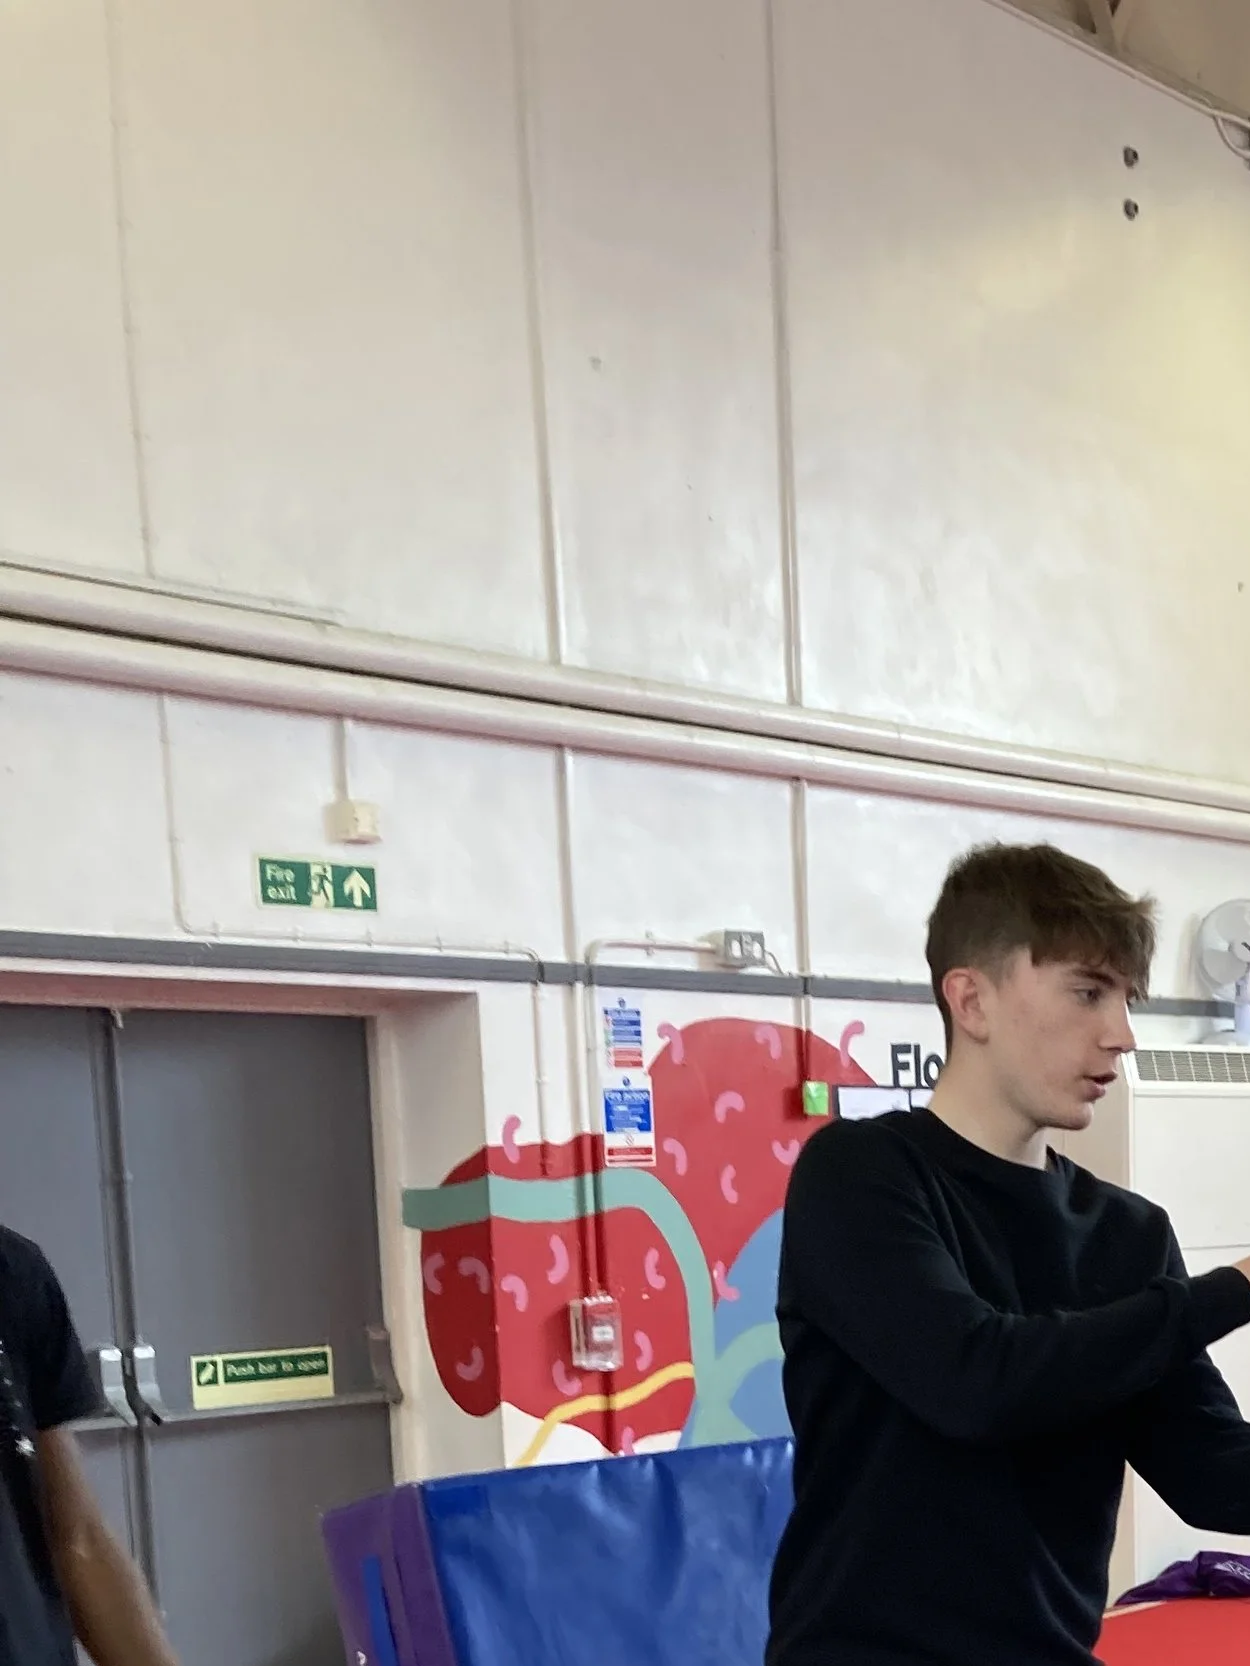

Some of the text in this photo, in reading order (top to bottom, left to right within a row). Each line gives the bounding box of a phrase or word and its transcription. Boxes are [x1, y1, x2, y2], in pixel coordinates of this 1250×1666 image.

[265, 864, 295, 884] Fire
[267, 884, 297, 901] exit
[890, 1043, 945, 1089] Flo
[226, 1363, 256, 1377] Push
